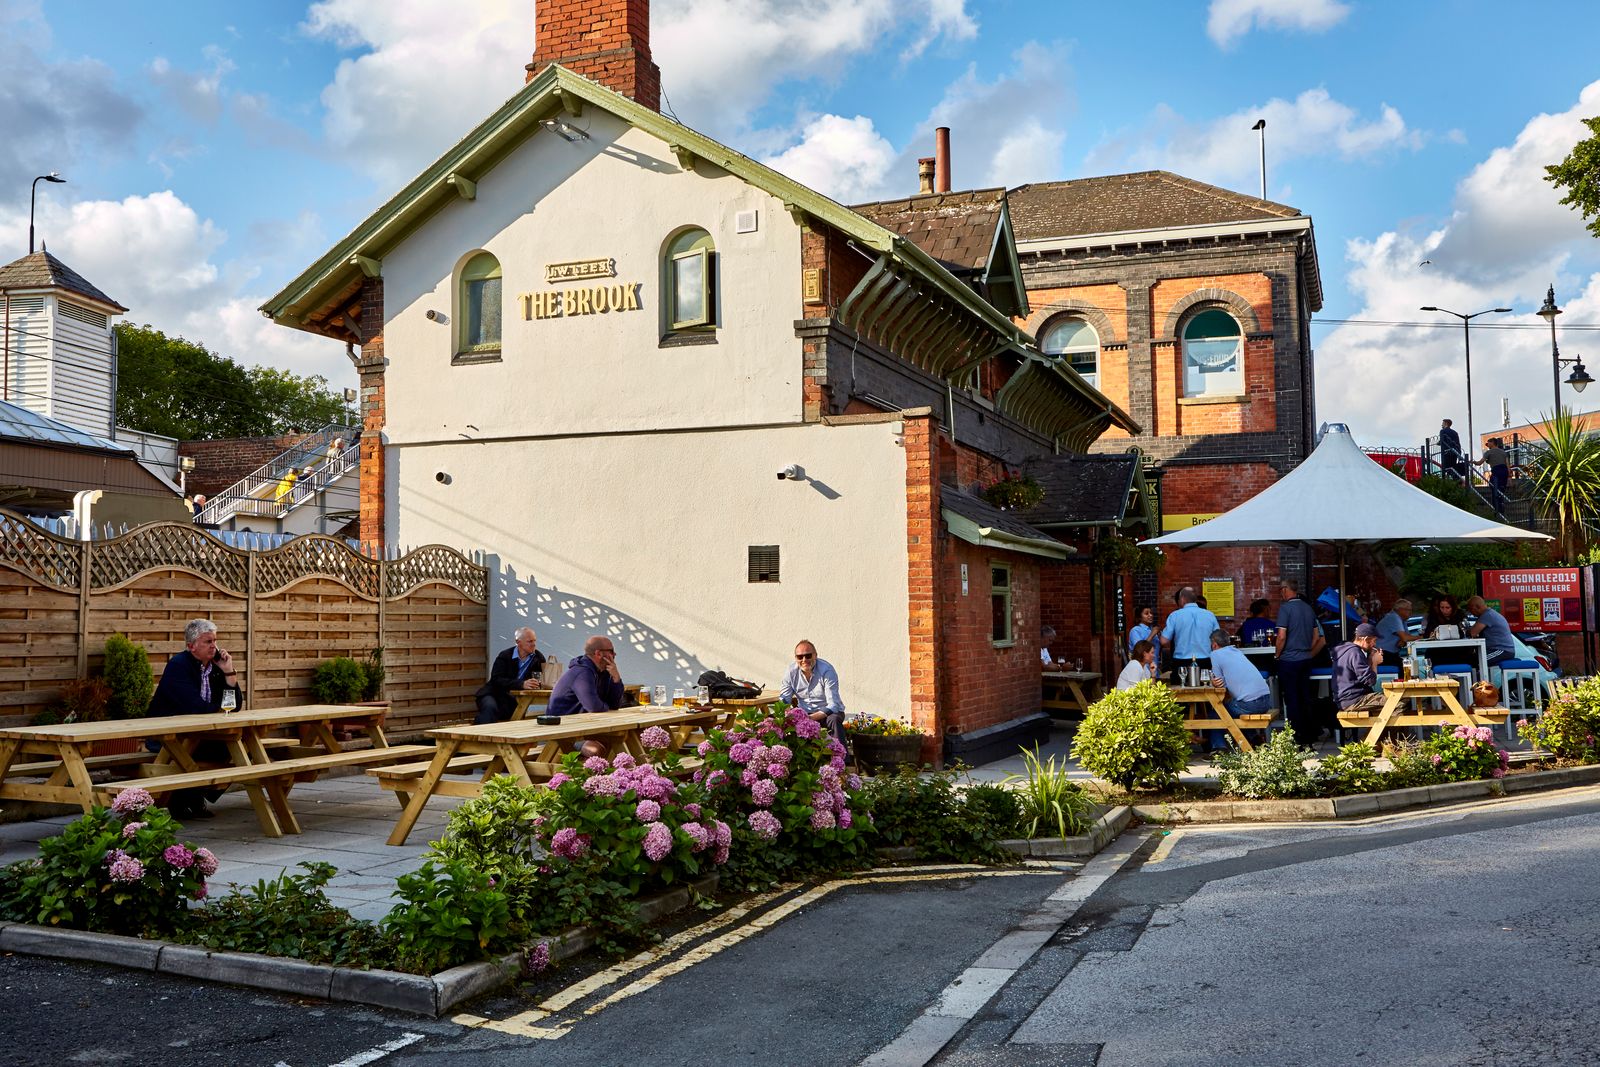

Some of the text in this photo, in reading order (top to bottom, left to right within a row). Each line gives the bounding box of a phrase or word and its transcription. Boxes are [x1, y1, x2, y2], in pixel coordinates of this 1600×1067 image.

[517, 282, 638, 320] THE BROOK
[1510, 584, 1571, 593] AVAILABLE HERE
